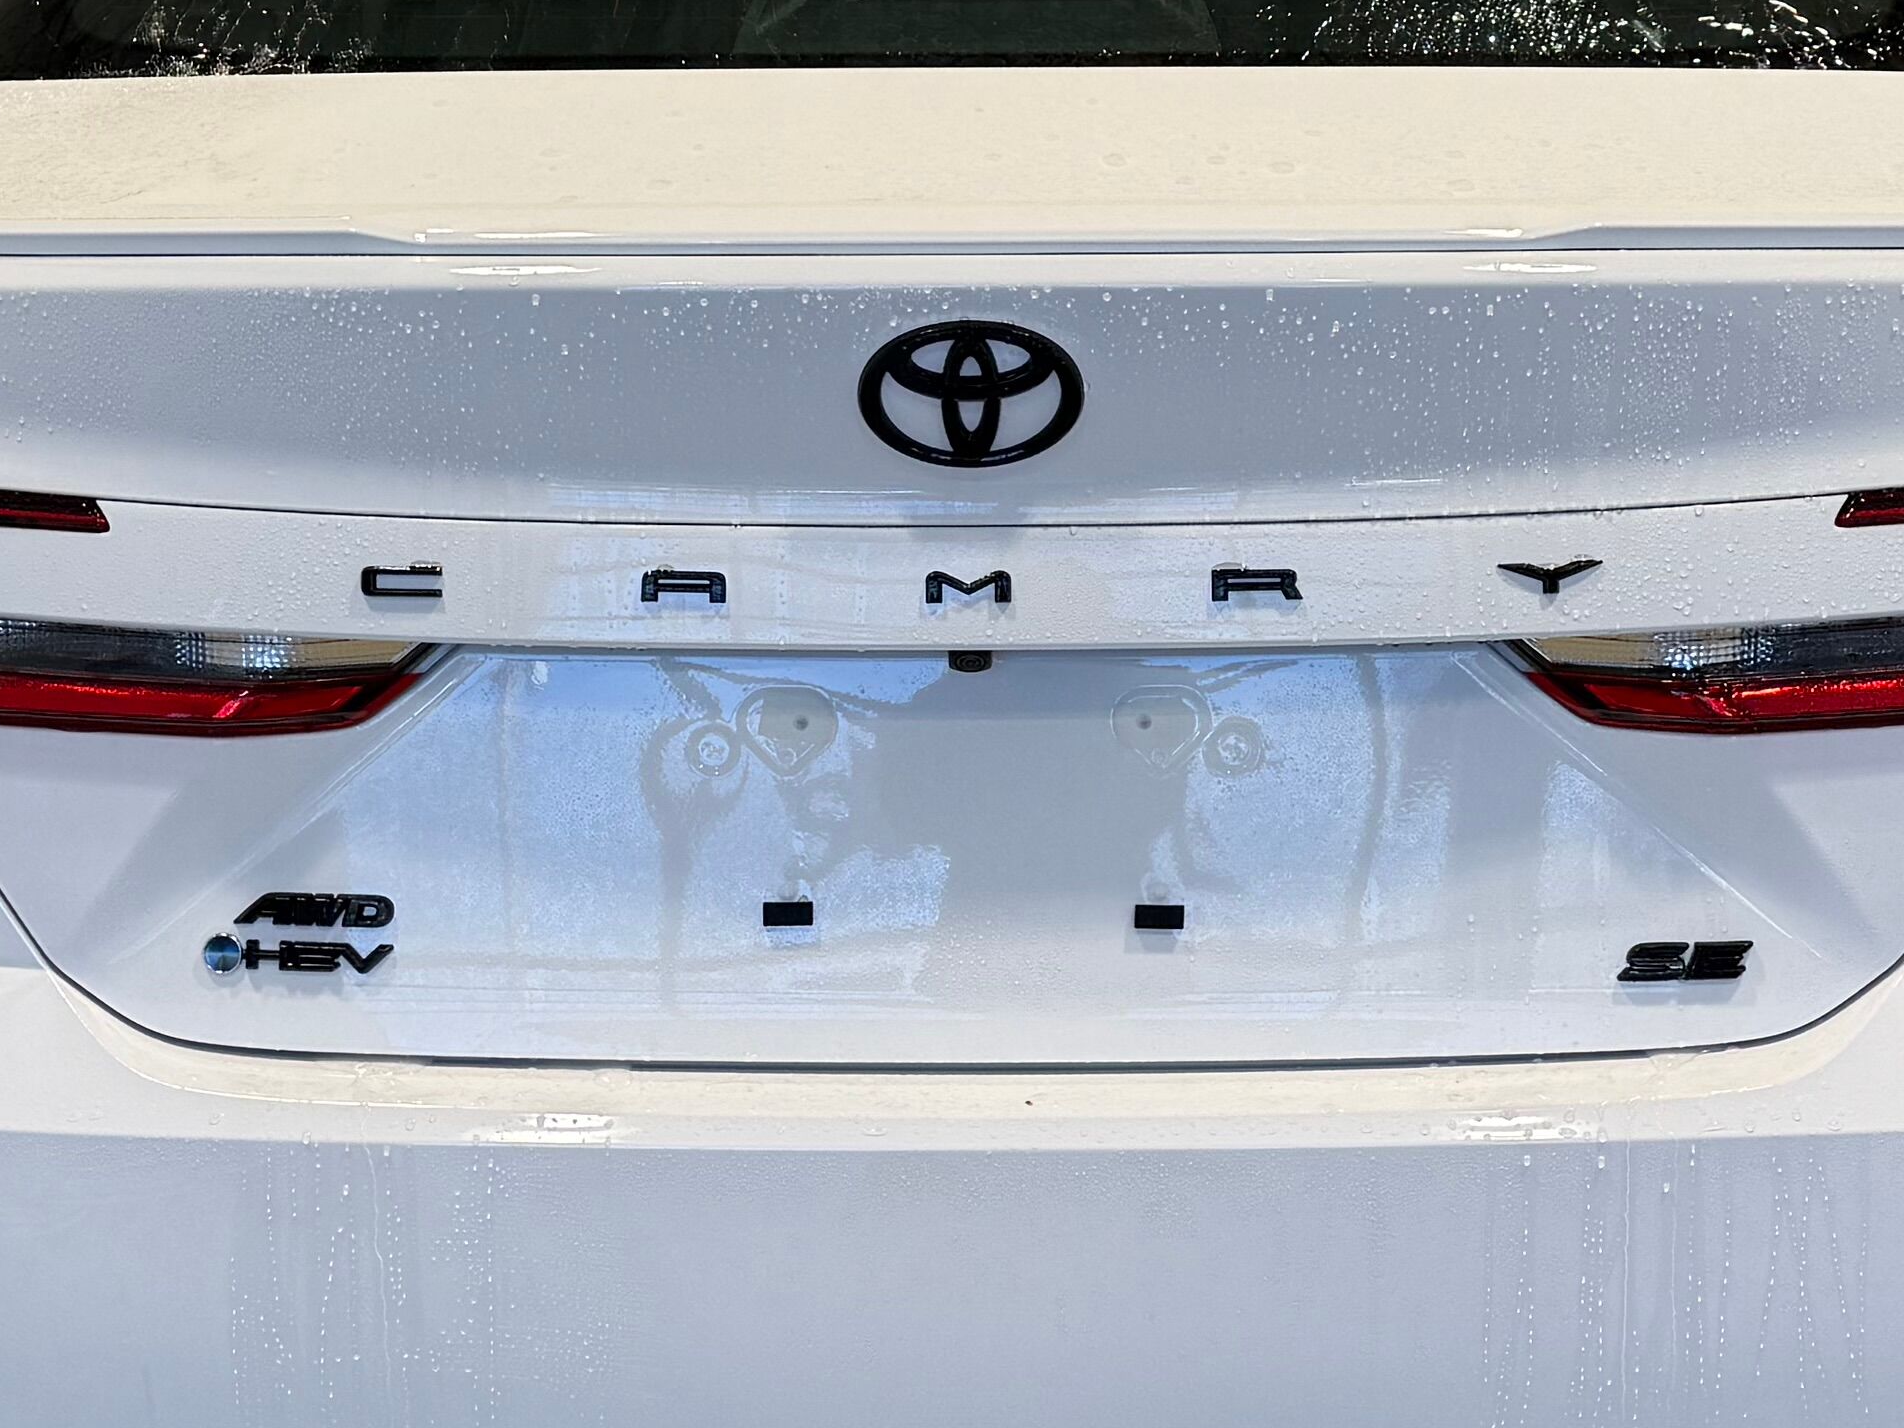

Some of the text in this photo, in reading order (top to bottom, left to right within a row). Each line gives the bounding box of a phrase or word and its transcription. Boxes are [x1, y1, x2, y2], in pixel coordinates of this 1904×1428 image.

[360, 558, 1604, 603] CAMRY
[233, 892, 395, 928] AWD
[245, 939, 395, 974] HEV
[1616, 940, 1754, 982] SE
